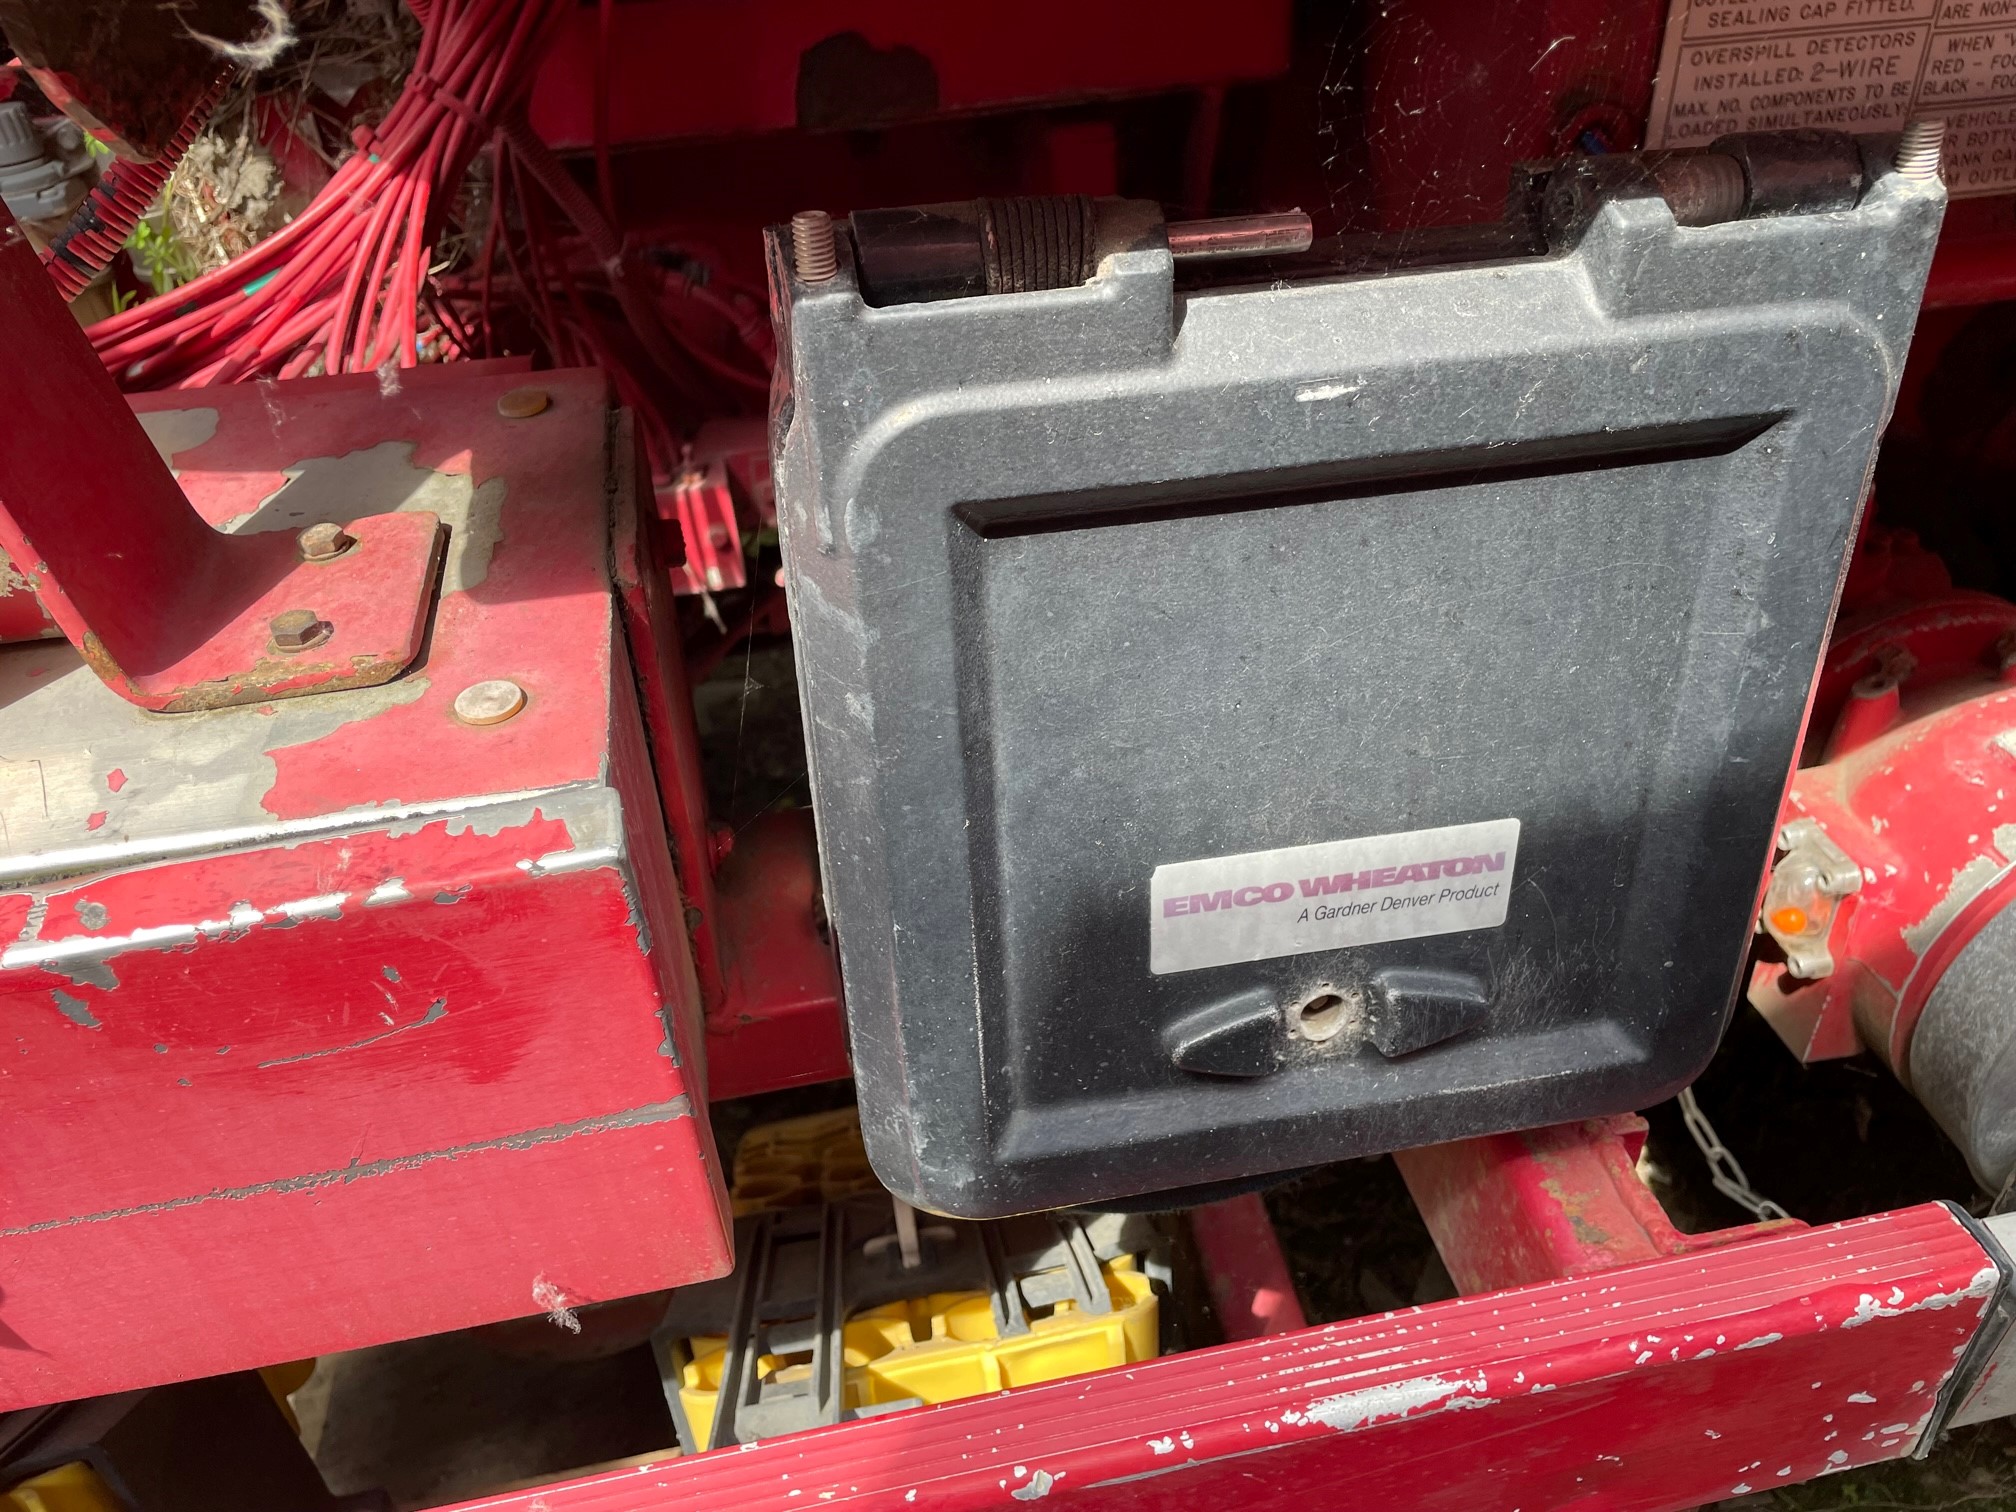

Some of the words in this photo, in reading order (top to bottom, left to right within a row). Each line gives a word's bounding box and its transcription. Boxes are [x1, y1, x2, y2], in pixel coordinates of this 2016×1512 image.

[1707, 6, 1790, 28] SEALING
[1800, 1, 1837, 20] CAP
[1942, 3, 1973, 19] ARE
[1690, 40, 1796, 67] OVERSPILL
[1806, 31, 1916, 56] DETECTORS
[1948, 35, 1995, 52] WHEN
[1810, 54, 1900, 83] 2-WIRE
[1932, 58, 1965, 76] RED
[1750, 86, 1856, 112] COMPONENTS
[1865, 82, 1884, 100] TO
[1890, 80, 1912, 98] BE
[1923, 78, 1970, 96] BLACK
[1664, 119, 1738, 140] LOADED
[1163, 882, 1295, 918] EMCO
[1298, 852, 1506, 898] WHEATON
[1297, 908, 1309, 923] A
[1314, 900, 1377, 921] Gardner
[1380, 892, 1436, 912] Denver
[1438, 881, 1501, 904] Product
